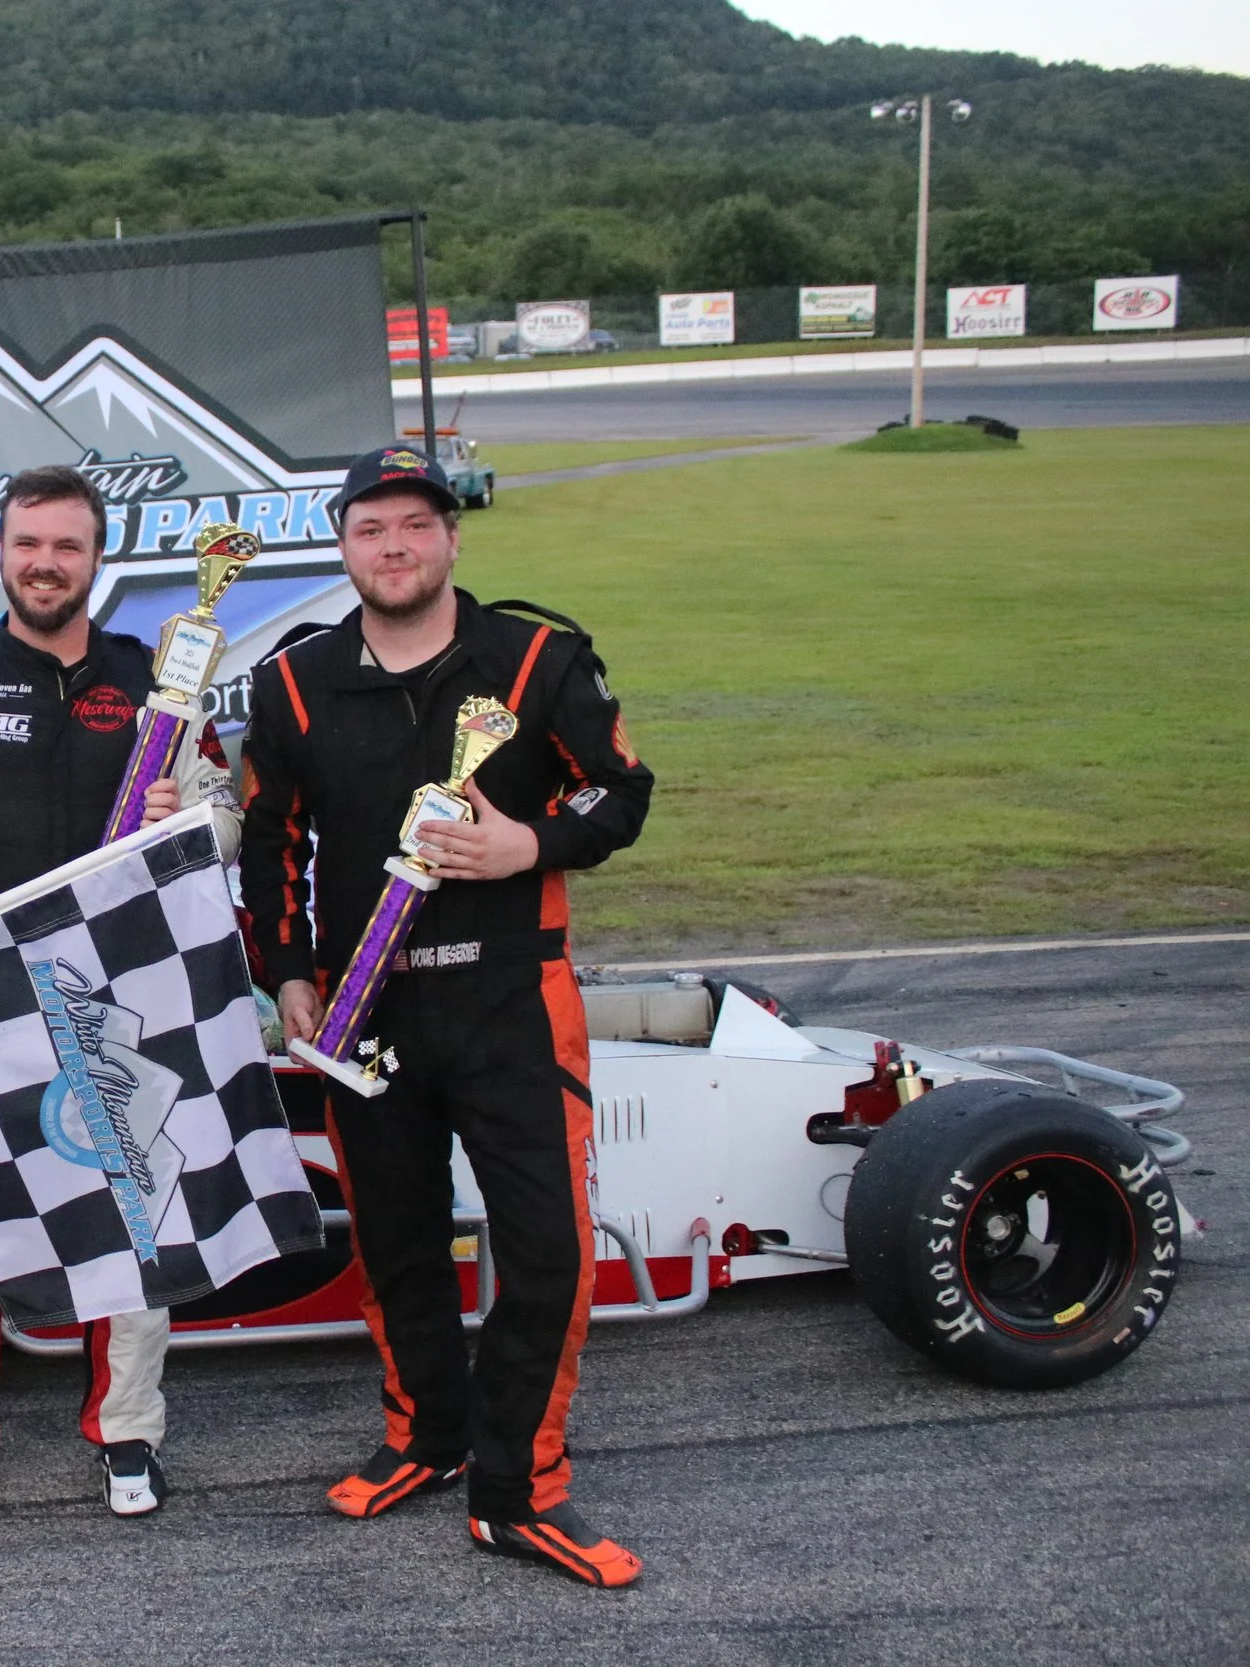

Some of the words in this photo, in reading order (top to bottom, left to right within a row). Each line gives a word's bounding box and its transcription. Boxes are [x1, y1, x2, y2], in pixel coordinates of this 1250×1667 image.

[960, 287, 1012, 306] ACT
[952, 313, 1022, 333] Hoosier
[383, 455, 428, 467] SUNOCO
[130, 486, 343, 556] PARK
[162, 669, 175, 679] 1st
[176, 673, 199, 687] Place
[19, 683, 33, 693] Gas
[11, 735, 29, 743] Group
[198, 780, 210, 790] One
[405, 835, 423, 848] 2nd
[410, 947, 436, 969] DOUG
[53, 956, 107, 1058] White
[89, 1056, 156, 1198] Mountain
[26, 958, 129, 1175] MOTORSPORTS
[111, 1177, 160, 1268] PARK
[1119, 1151, 1176, 1328] Hoosier
[918, 1169, 987, 1343] Hoosier
